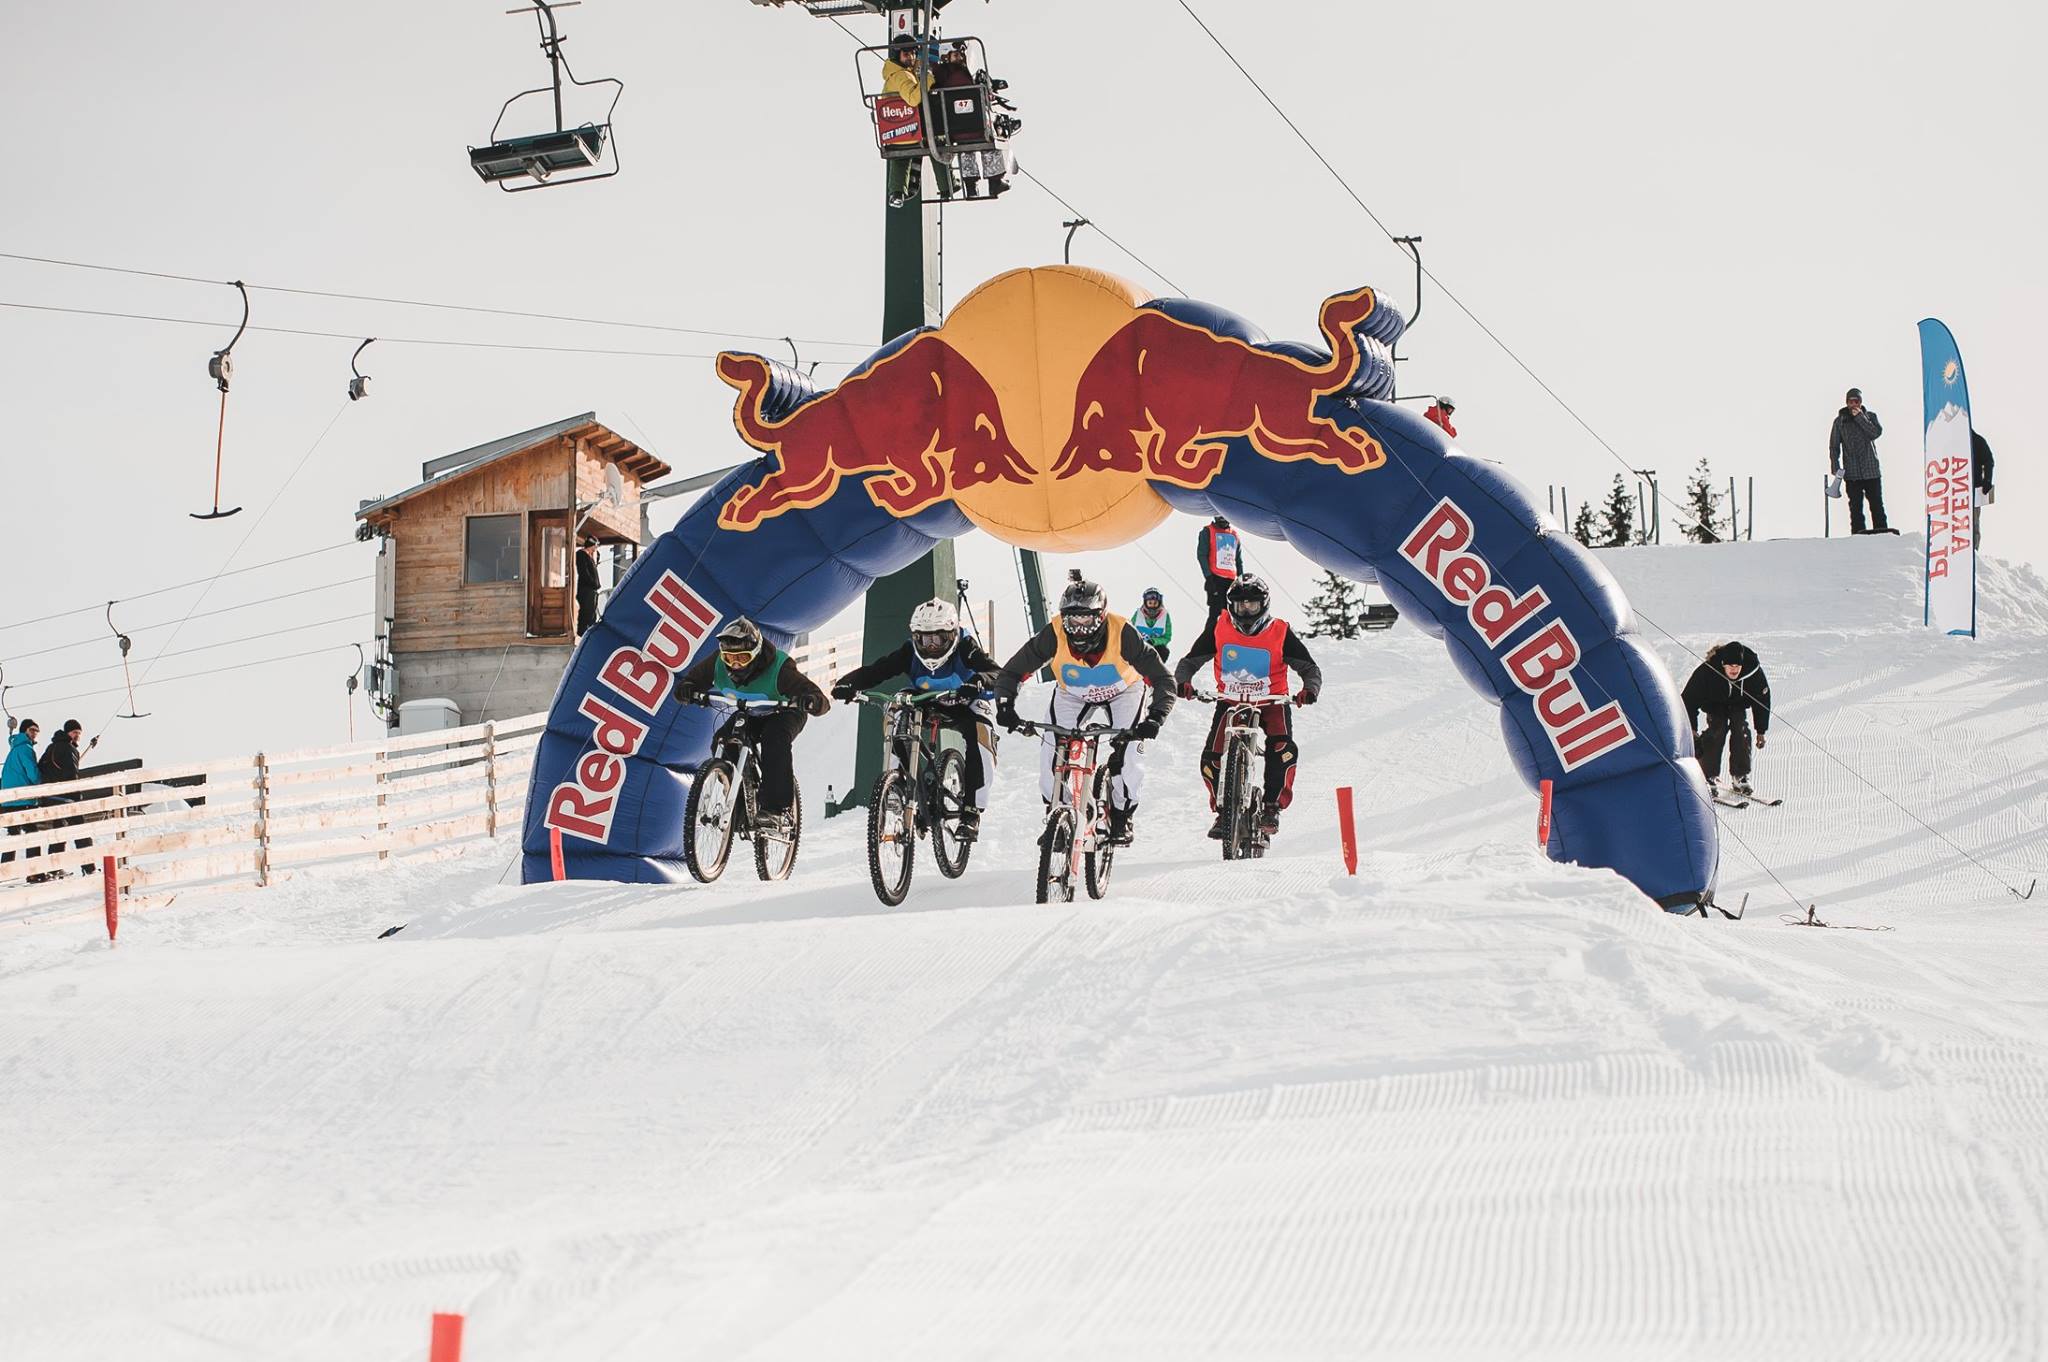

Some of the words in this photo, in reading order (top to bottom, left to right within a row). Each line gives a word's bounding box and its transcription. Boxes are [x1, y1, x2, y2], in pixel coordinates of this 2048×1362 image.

[898, 13, 906, 30] 6
[882, 105, 914, 119] Hervis
[882, 131, 894, 141] GET
[1401, 500, 1547, 646] Red
[1503, 620, 1632, 769] Bull
[546, 695, 646, 841] Red
[600, 572, 719, 713] Bull
